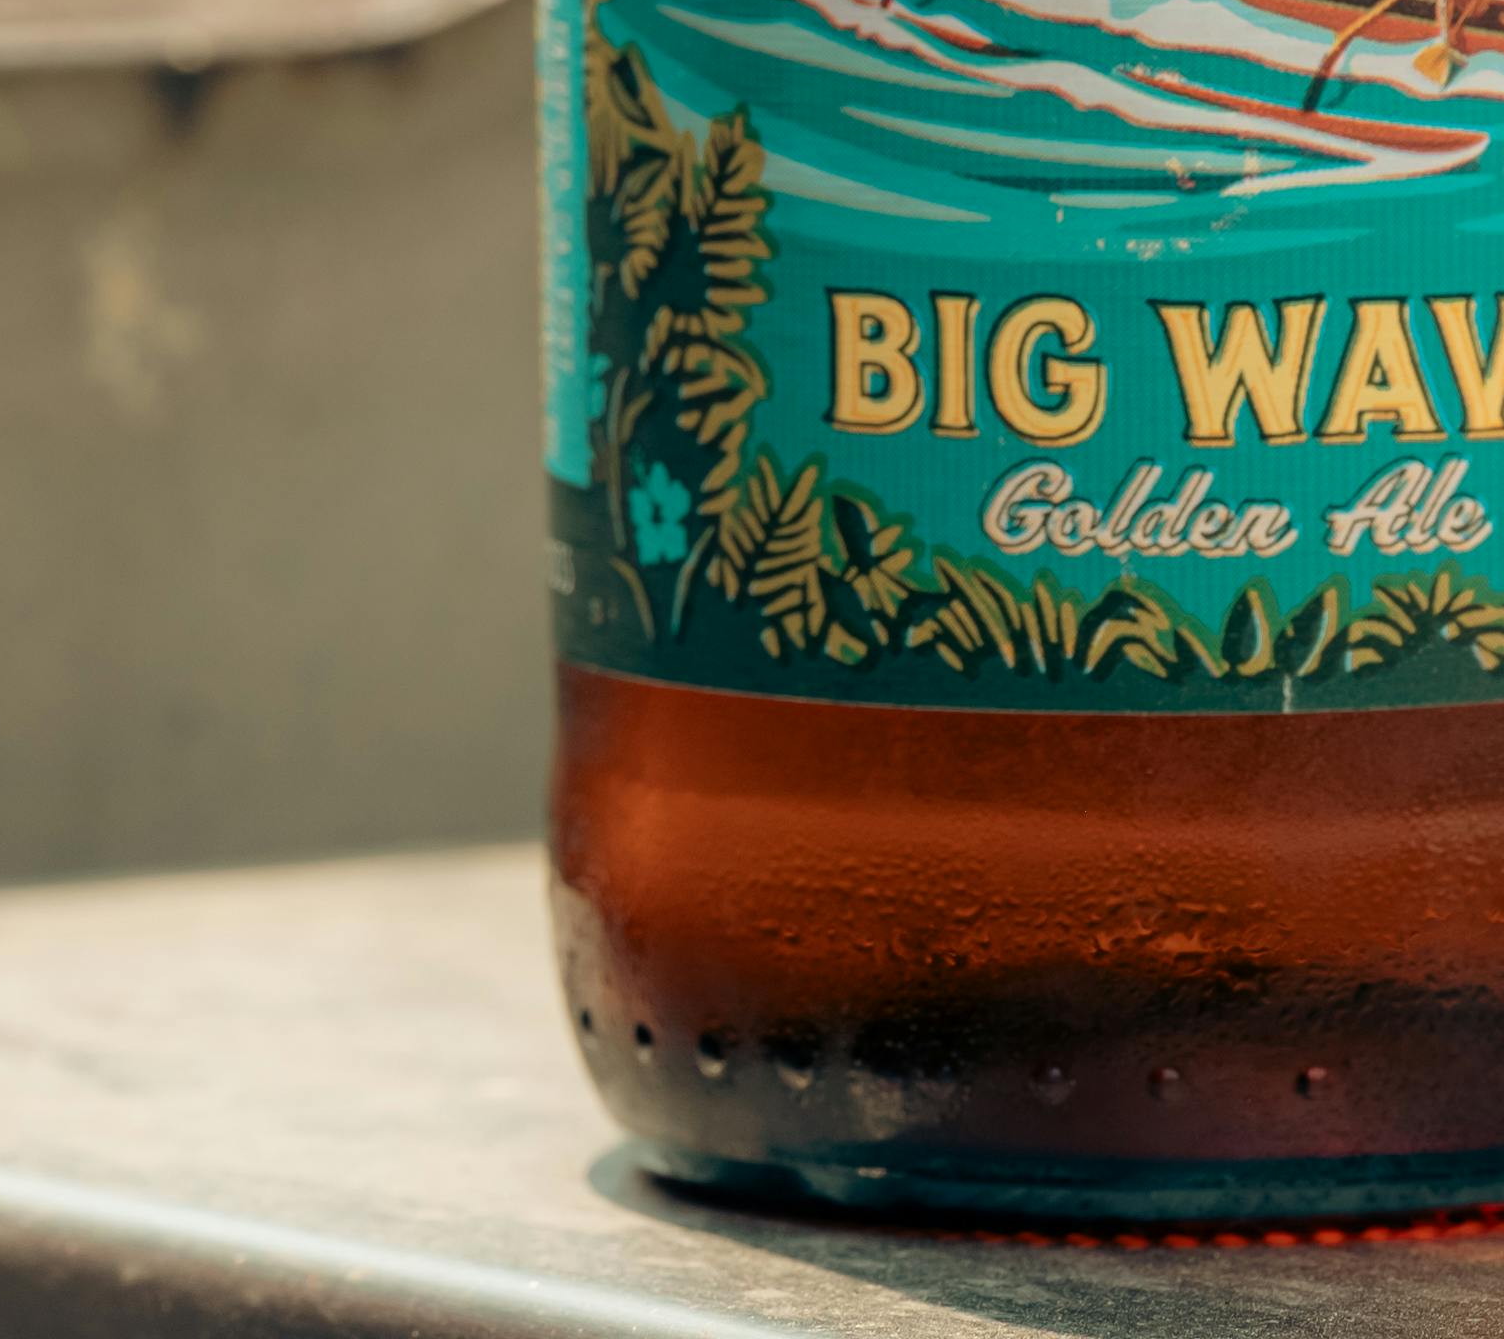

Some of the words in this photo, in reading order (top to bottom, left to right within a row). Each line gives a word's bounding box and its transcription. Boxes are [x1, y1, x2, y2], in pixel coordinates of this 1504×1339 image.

[826, 286, 1108, 447] BIG
[981, 457, 1297, 556] Golden
[1325, 455, 1494, 555] Ale
